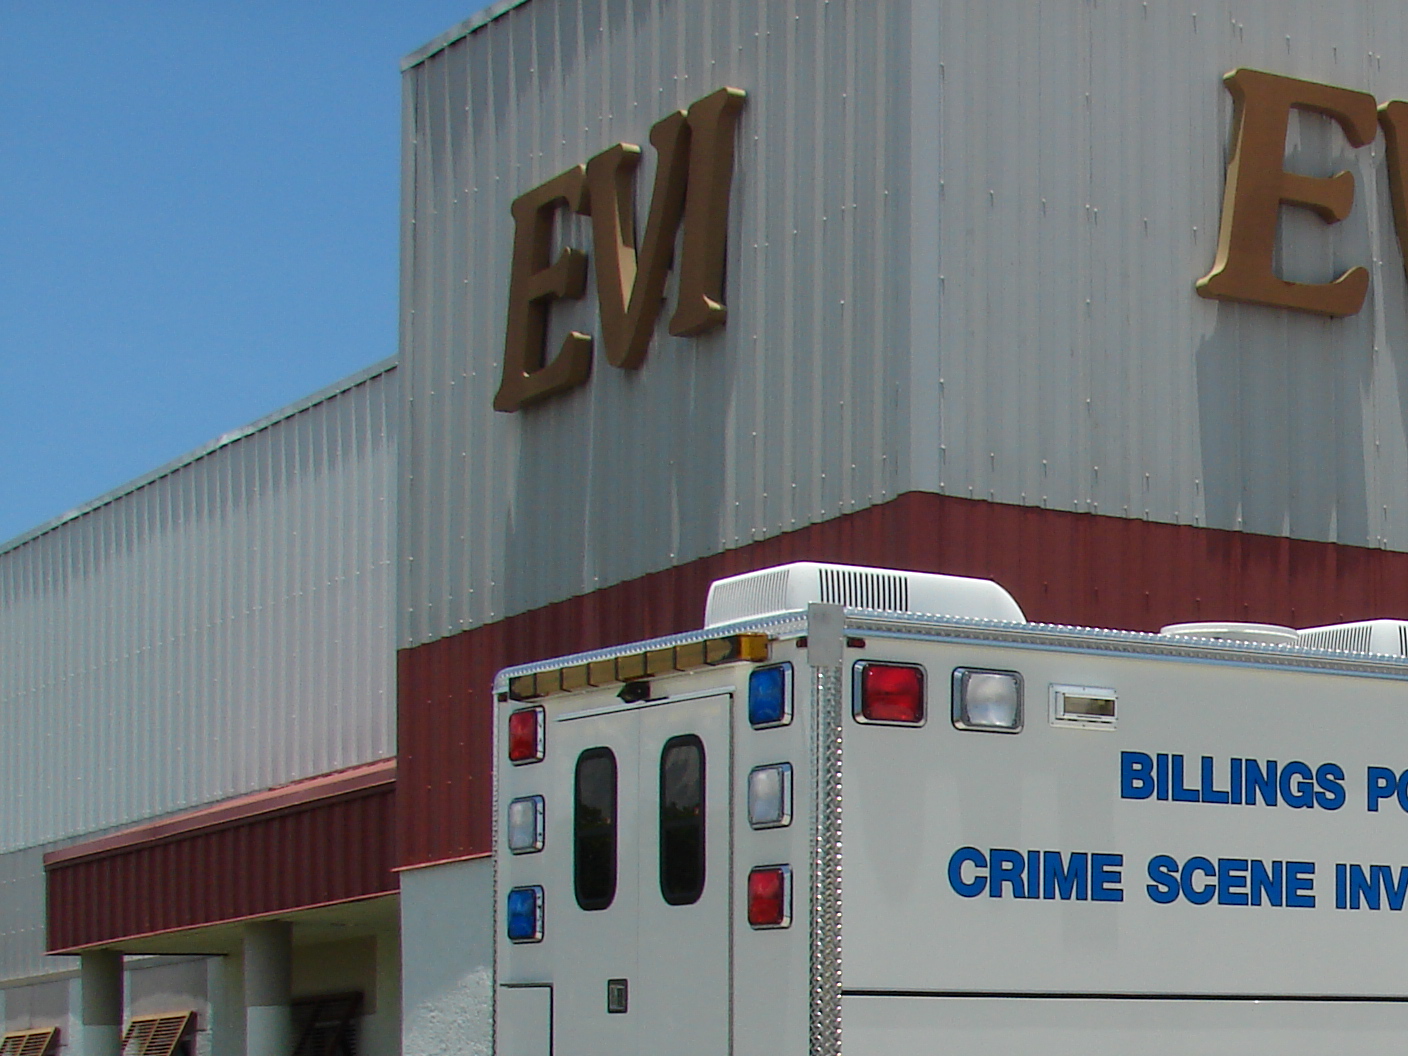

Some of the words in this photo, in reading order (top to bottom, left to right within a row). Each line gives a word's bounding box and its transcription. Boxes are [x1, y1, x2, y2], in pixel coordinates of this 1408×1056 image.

[494, 87, 747, 412] EVI
[1120, 751, 1346, 811] BILLINGS
[947, 847, 1124, 902] CRIME
[1146, 855, 1316, 908] SCENE
